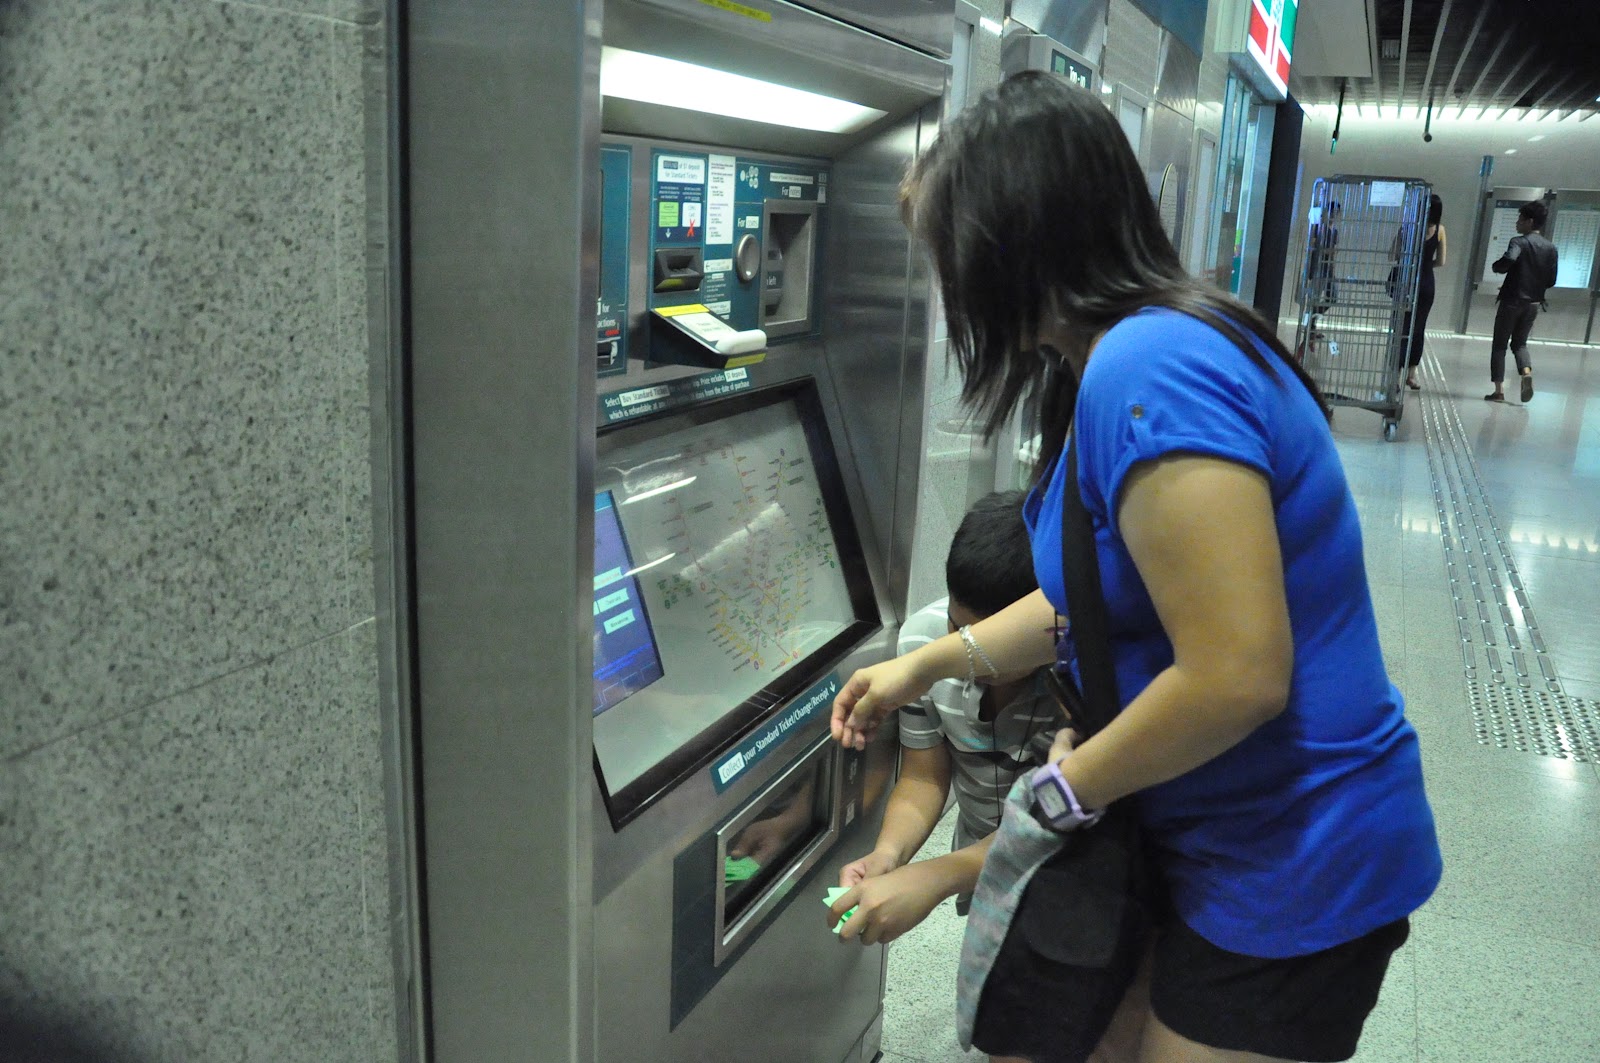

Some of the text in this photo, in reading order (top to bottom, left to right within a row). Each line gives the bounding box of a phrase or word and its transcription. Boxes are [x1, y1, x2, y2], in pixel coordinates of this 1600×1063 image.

[781, 186, 789, 196] For
[737, 217, 745, 227] For
[605, 397, 620, 407] Select
[633, 389, 653, 400] Standard
[710, 374, 725, 383] includes
[609, 409, 624, 420] which
[721, 688, 830, 779] Collect your Standard Ticket/Change/Receipt
